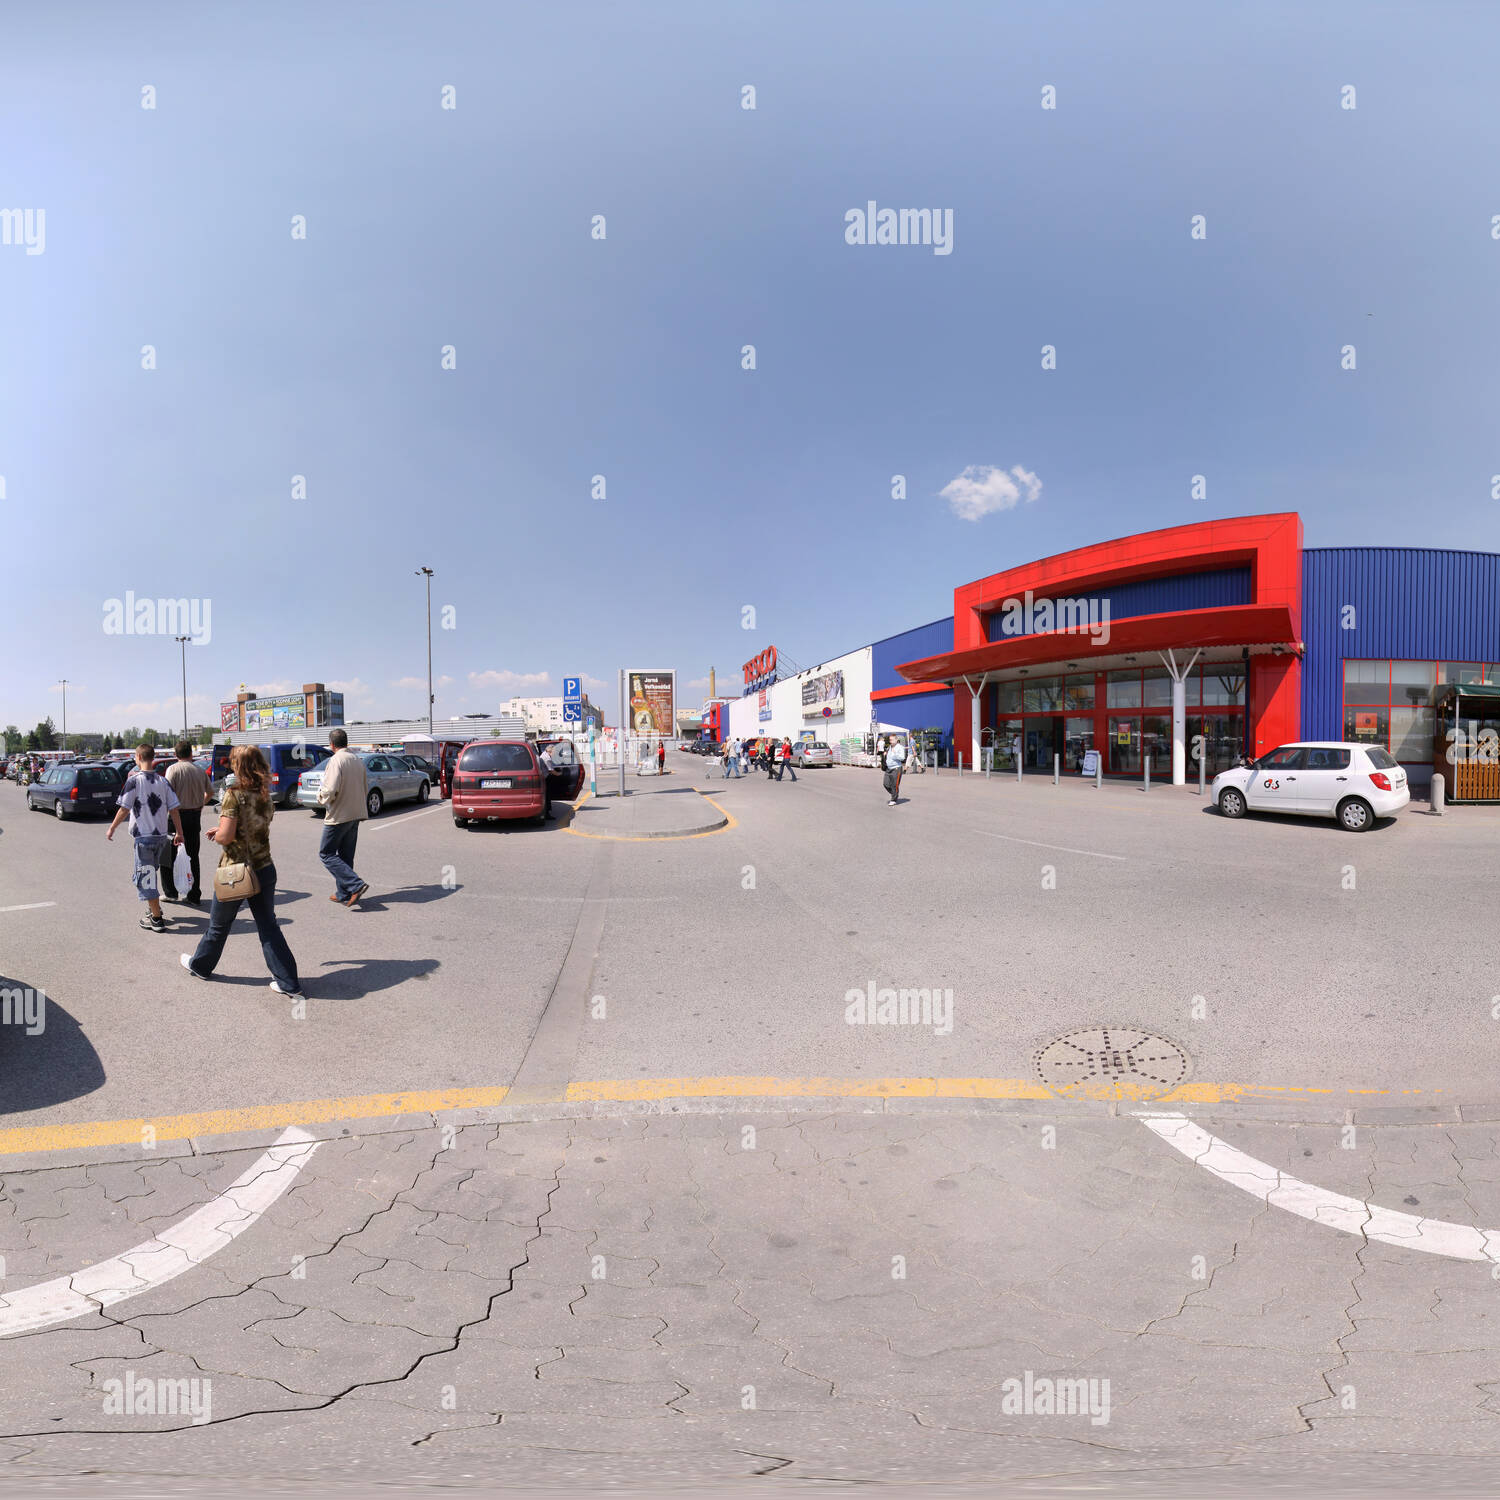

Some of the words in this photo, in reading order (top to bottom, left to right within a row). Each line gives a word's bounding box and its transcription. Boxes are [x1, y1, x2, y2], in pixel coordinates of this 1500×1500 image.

[742, 645, 777, 684] TESCO
[567, 680, 576, 694] P
[1264, 779, 1280, 790] G4S
